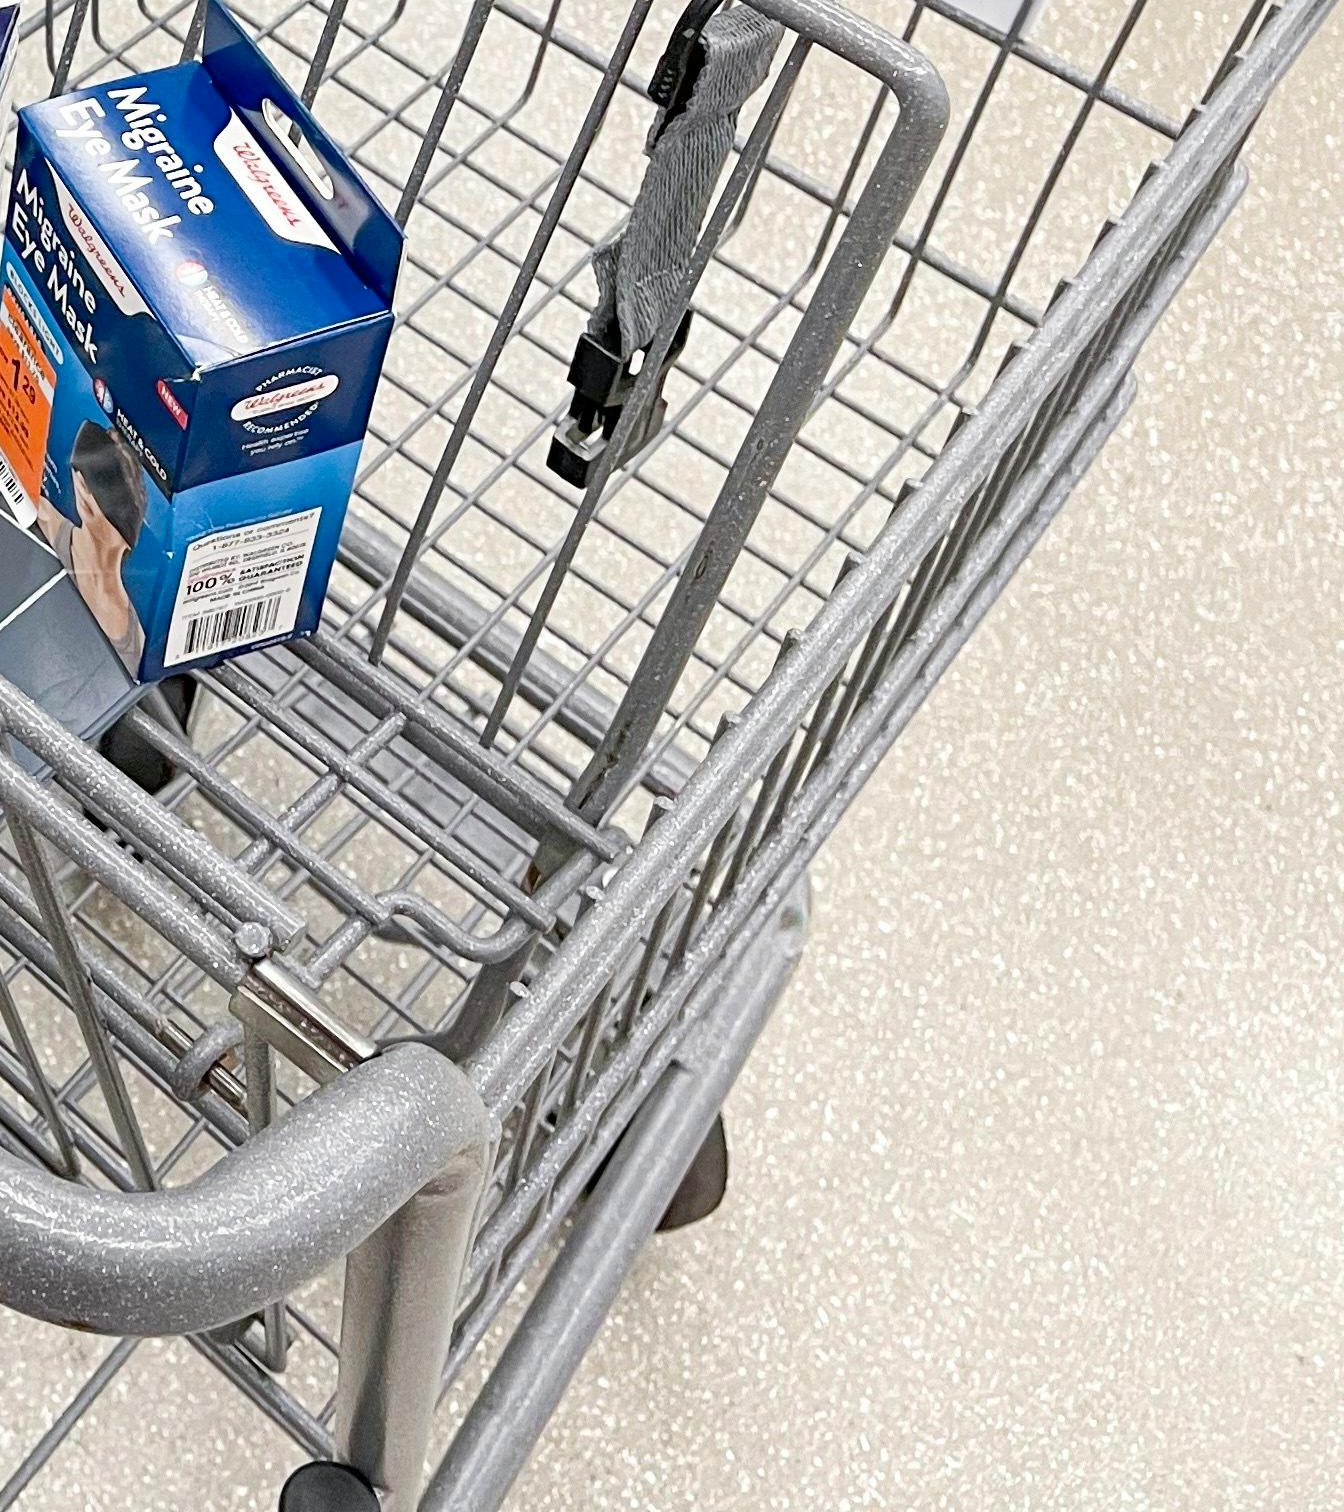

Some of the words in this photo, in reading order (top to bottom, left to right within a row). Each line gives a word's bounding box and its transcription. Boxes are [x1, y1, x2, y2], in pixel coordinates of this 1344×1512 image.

[55, 97, 112, 157] Eye
[98, 158, 182, 245] Mask
[107, 87, 214, 216] Migraine
[232, 141, 302, 228] Walgreens
[16, 168, 97, 314] Migraine
[68, 203, 125, 297] Walgreens
[11, 201, 45, 274] Eye
[47, 265, 98, 364] Mask
[244, 382, 325, 410] Walgreens
[255, 365, 323, 392] PHARMACIST
[160, 383, 181, 416] NEW
[242, 401, 319, 434] RECOMMENDED
[116, 409, 139, 441] HEAT
[143, 442, 167, 482] COLD
[192, 532, 241, 552] Questions
[256, 512, 315, 534] comments?
[186, 571, 236, 596] 100%
[238, 561, 303, 582] GUARANTEED
[239, 553, 305, 575] SATISFACTION
